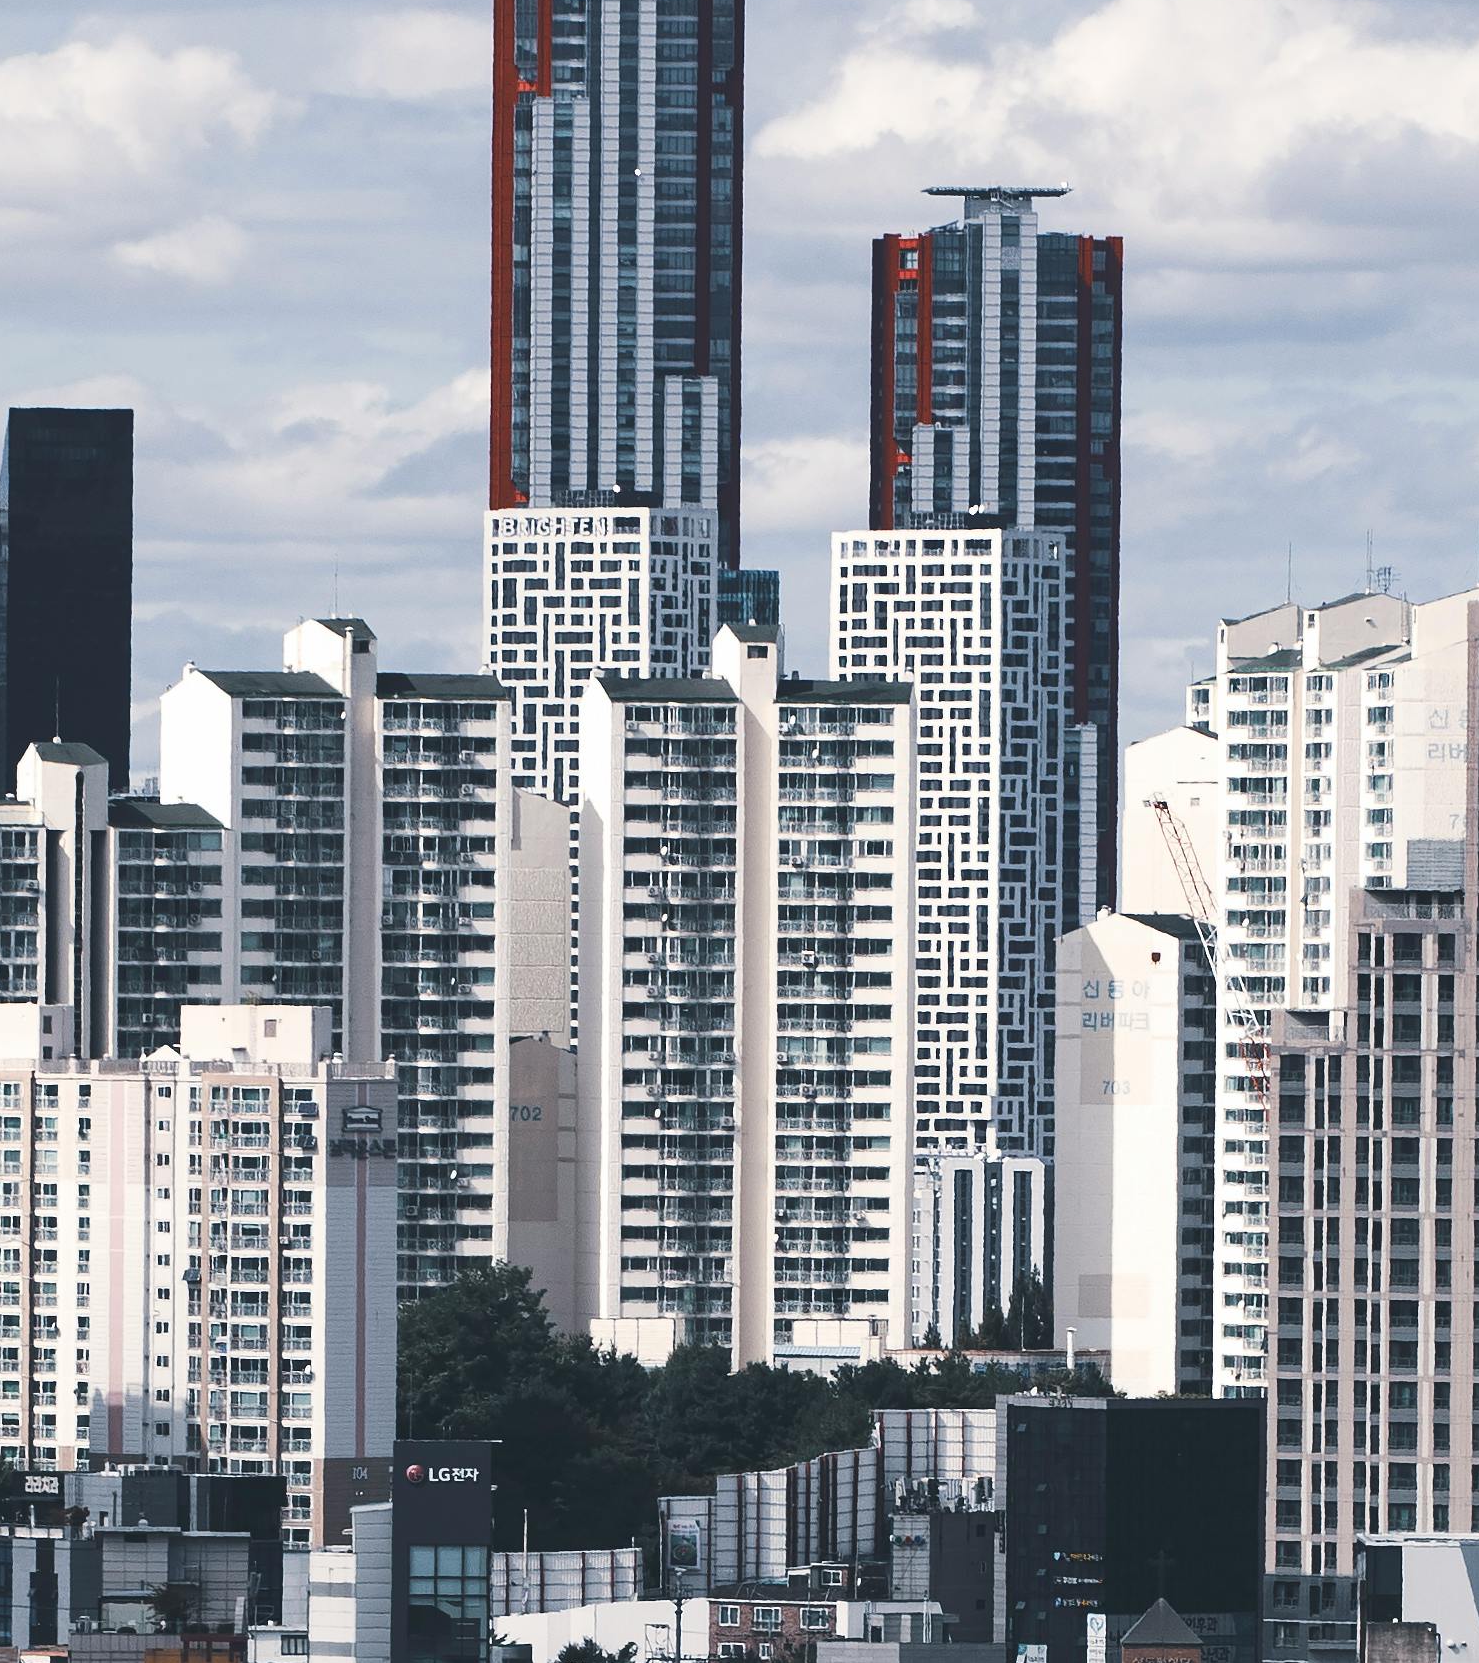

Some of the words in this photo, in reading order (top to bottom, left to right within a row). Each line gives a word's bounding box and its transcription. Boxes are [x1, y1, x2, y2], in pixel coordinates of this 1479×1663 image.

[1083, 979, 1150, 999] 신동아
[1082, 1012, 1149, 1032] 리버파크
[1102, 1081, 1130, 1095] 703
[511, 1105, 542, 1122] 702
[428, 1467, 480, 1482] LG전자
